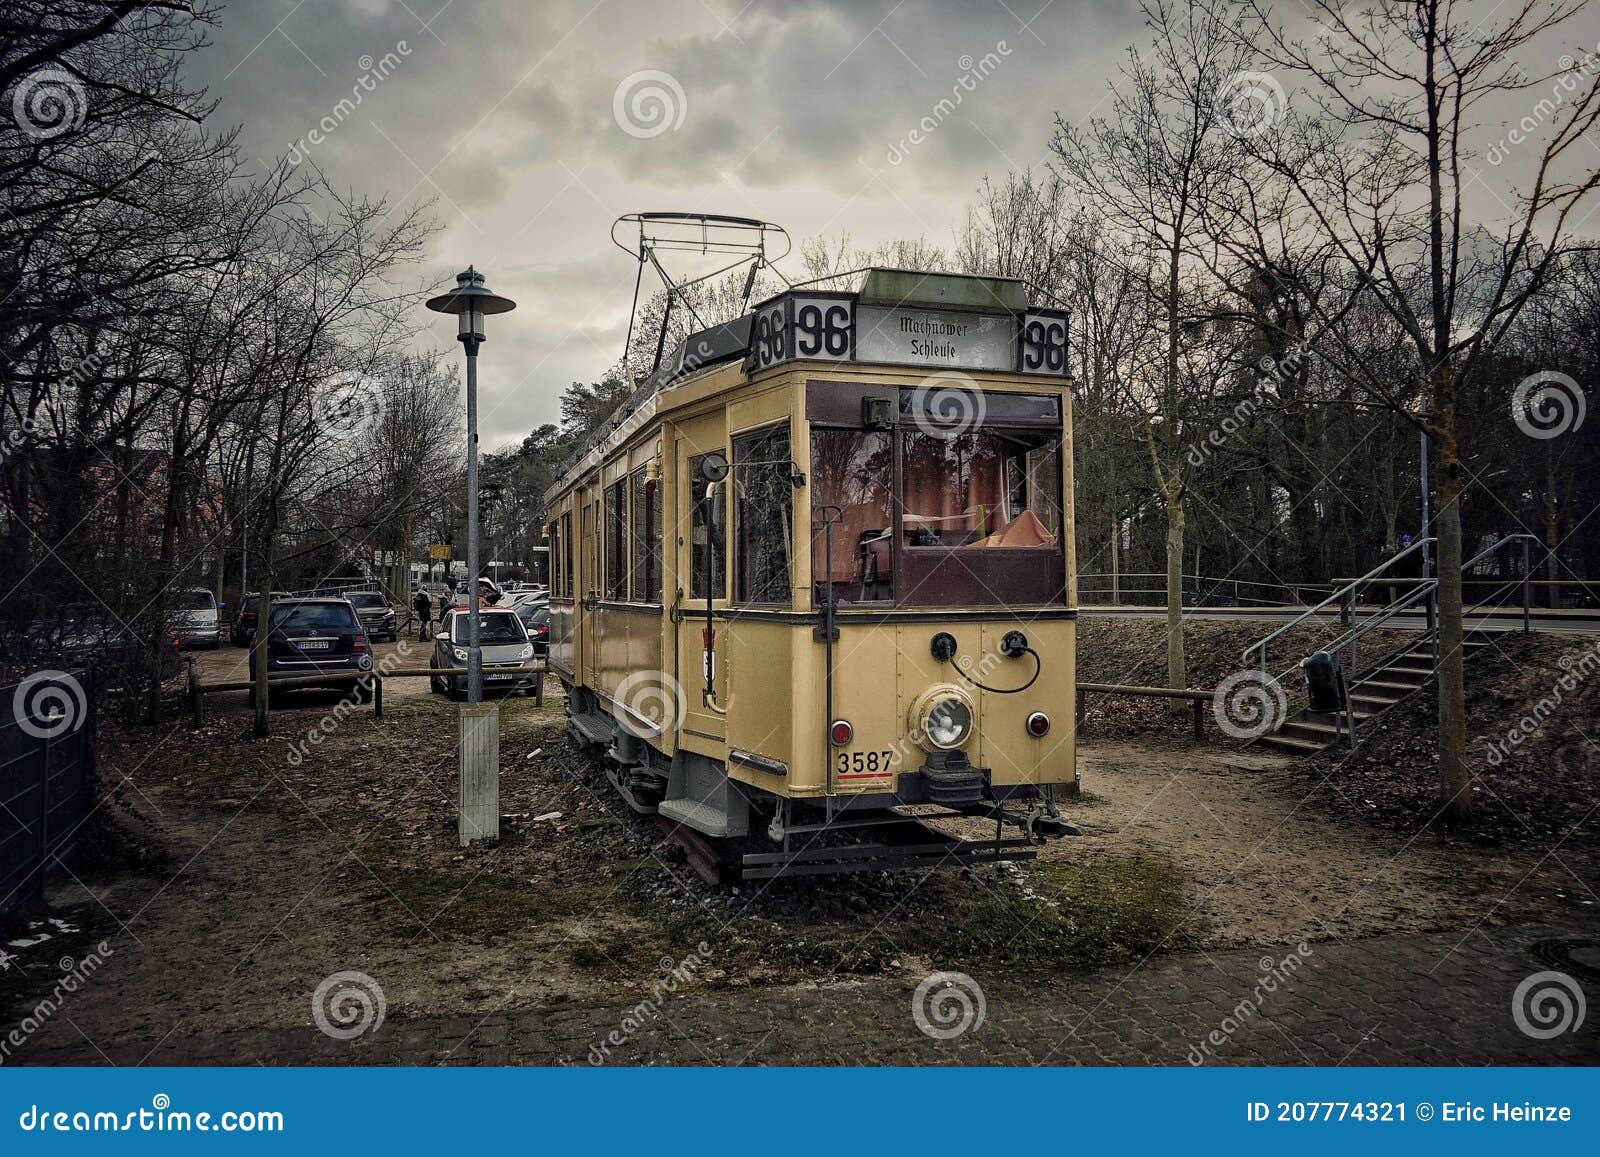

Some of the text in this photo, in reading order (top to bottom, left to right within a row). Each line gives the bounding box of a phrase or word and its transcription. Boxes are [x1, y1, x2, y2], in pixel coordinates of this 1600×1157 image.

[760, 309, 785, 365] 96
[798, 304, 849, 356] 96
[900, 316, 968, 338] Machnower
[1025, 320, 1065, 371] 96
[837, 751, 894, 773] 3587
